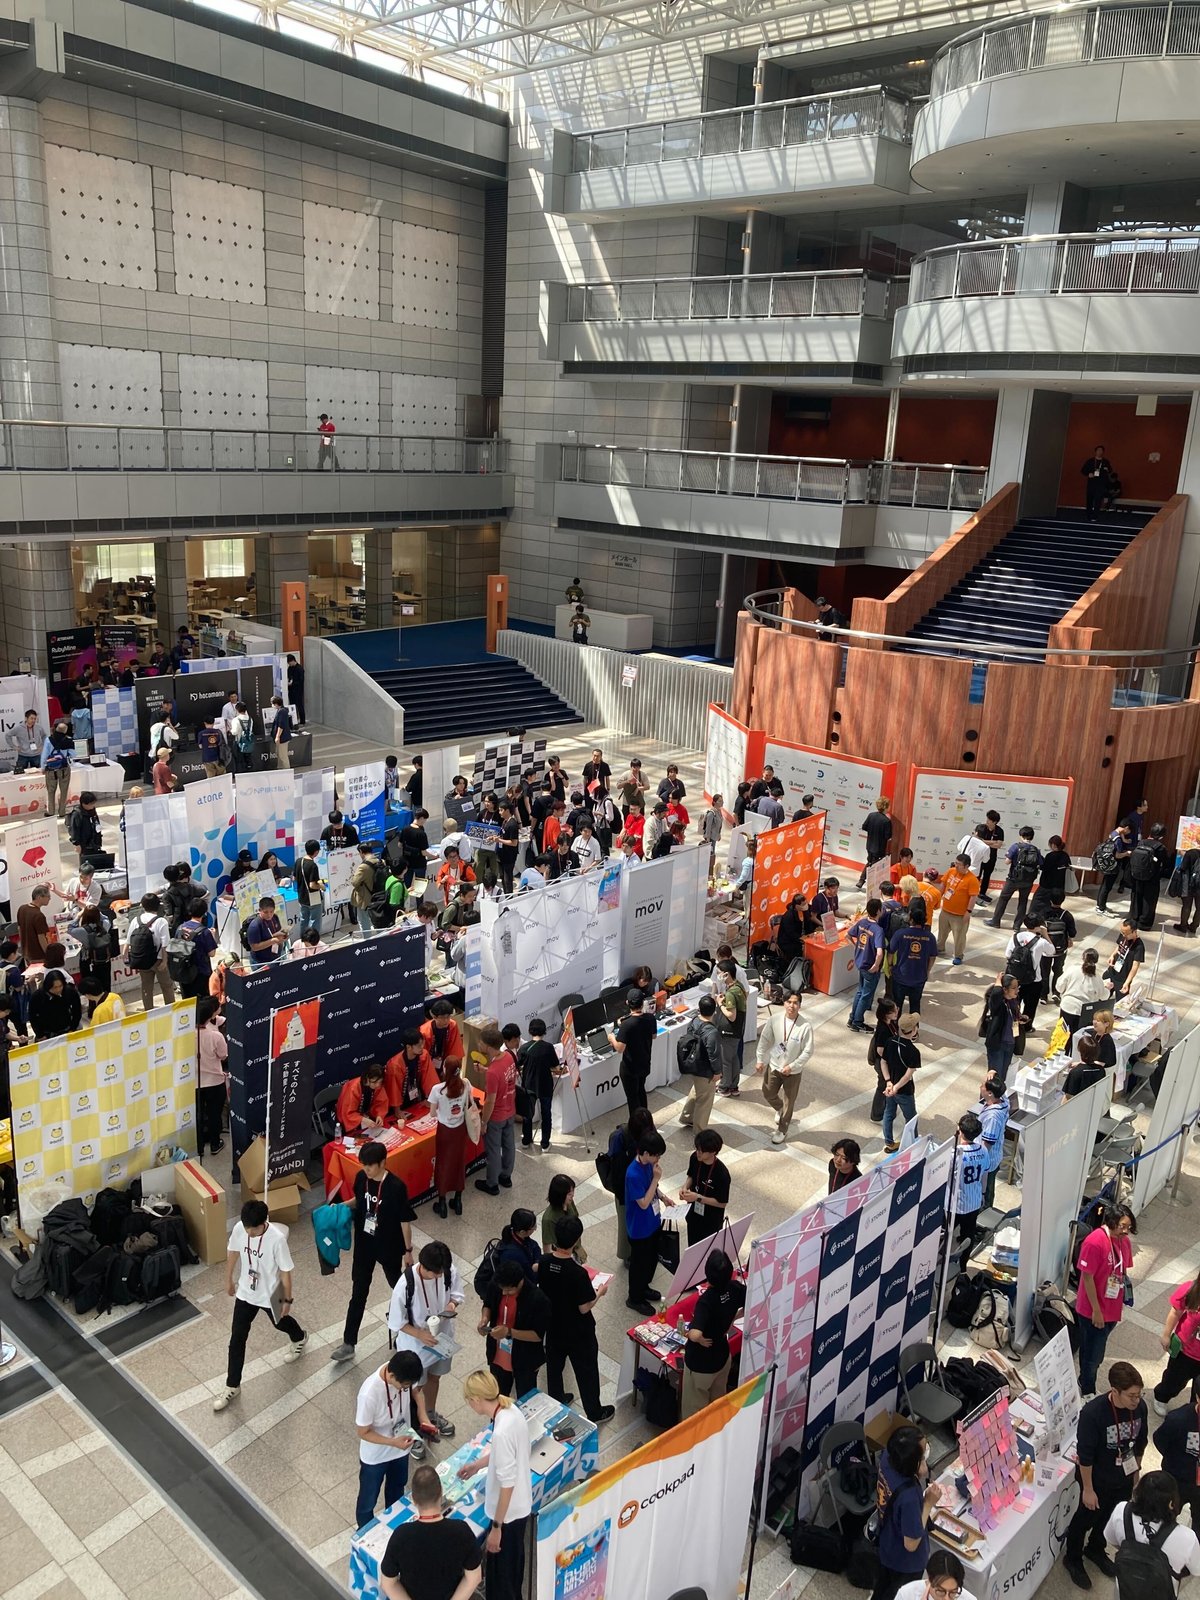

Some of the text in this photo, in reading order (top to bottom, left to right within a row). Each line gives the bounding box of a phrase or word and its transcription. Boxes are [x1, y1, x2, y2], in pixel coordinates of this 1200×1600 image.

[52, 645, 76, 654] RubyMine
[196, 790, 223, 806] atone
[635, 900, 664, 918] mov
[526, 922, 539, 930] mov
[361, 945, 377, 953] ITANDI
[309, 960, 326, 969] ITANDI
[253, 977, 271, 986] ITANDI
[335, 971, 351, 980] ITANDI
[281, 987, 298, 996] ITANDI
[361, 982, 377, 990] ITANDI
[546, 981, 559, 990] mov
[334, 1008, 350, 1017] ITANDI
[360, 1018, 376, 1026] ITANDI
[288, 1060, 300, 1103] すべての人の
[596, 1075, 620, 1096] mo
[275, 1160, 304, 1174] ITANDI
[964, 1164, 982, 1184] 81
[871, 1208, 886, 1223] STORES
[837, 1233, 854, 1247] STORES
[244, 1246, 263, 1258] mov
[864, 1255, 880, 1271] STORES
[830, 1282, 848, 1297] STORES
[915, 1289, 929, 1300] STORES
[858, 1302, 874, 1318] STORES
[882, 1321, 900, 1335] STORES
[825, 1330, 841, 1345] STORES
[879, 1366, 895, 1381] STORES
[841, 1440, 857, 1456] STORES
[640, 1464, 695, 1509] cookpad
[1004, 1547, 1042, 1594] STORES
